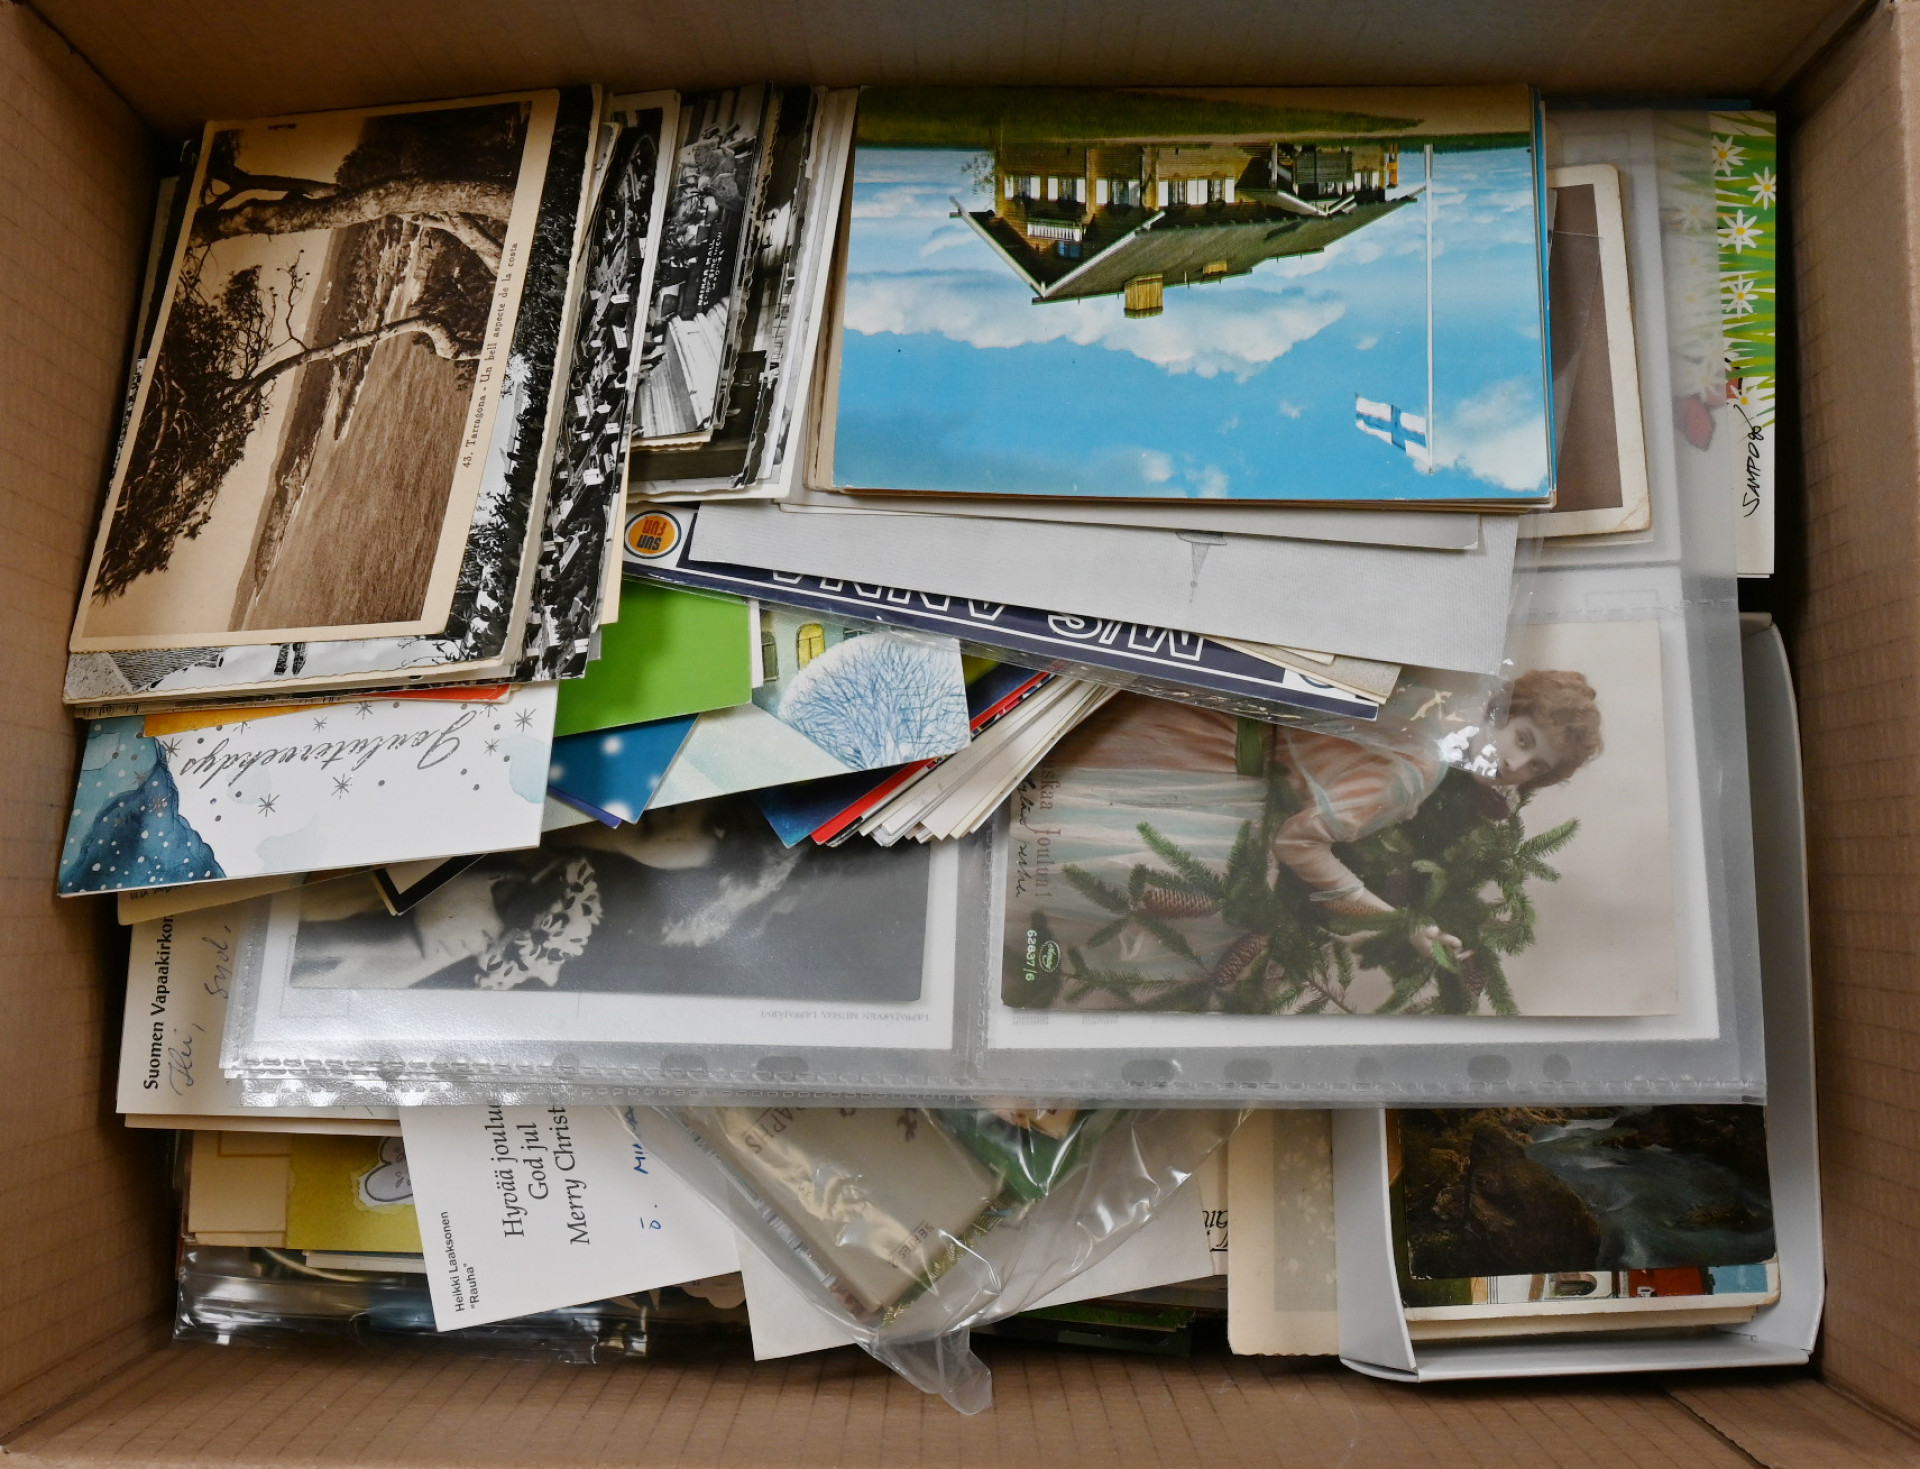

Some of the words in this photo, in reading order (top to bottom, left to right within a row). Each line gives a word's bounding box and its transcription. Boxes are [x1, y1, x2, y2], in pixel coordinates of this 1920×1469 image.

[508, 242, 518, 267] costa
[498, 287, 509, 298] de
[501, 273, 512, 282] la
[493, 303, 506, 338] aspecte
[484, 342, 497, 361] bell
[480, 366, 493, 383] Un
[466, 395, 487, 446] Tarragona
[144, 1022, 164, 1090] Suomen
[516, 1122, 548, 1151] jul
[522, 1156, 549, 1200] God
[494, 1168, 528, 1237] Hyvää
[564, 1178, 590, 1245] Merry
[441, 1211, 459, 1274] Laaksonen
[449, 1275, 465, 1312] Heikki
